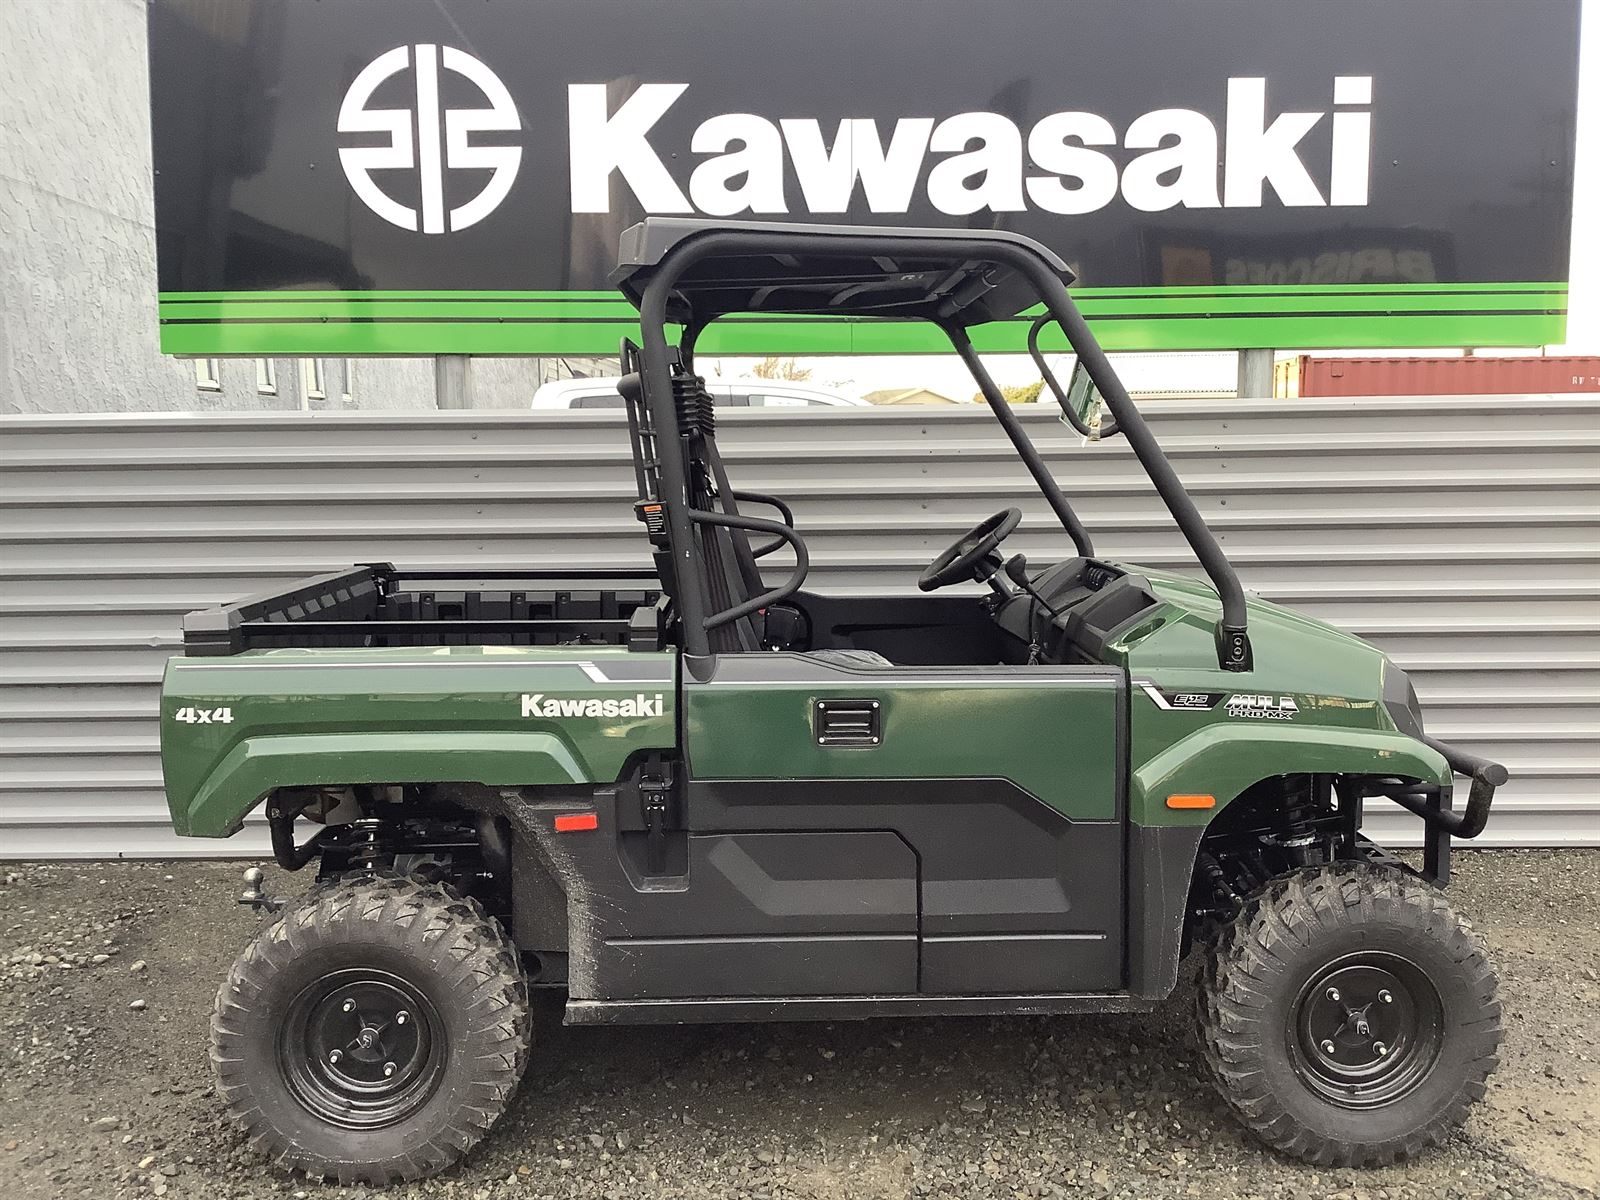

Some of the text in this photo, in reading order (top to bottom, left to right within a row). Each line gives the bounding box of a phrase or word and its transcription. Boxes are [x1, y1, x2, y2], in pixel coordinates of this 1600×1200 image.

[567, 76, 1373, 216] Kawasaki
[521, 693, 663, 717] Kawasaki
[1224, 694, 1300, 713] MULE
[175, 707, 235, 724] 4x4
